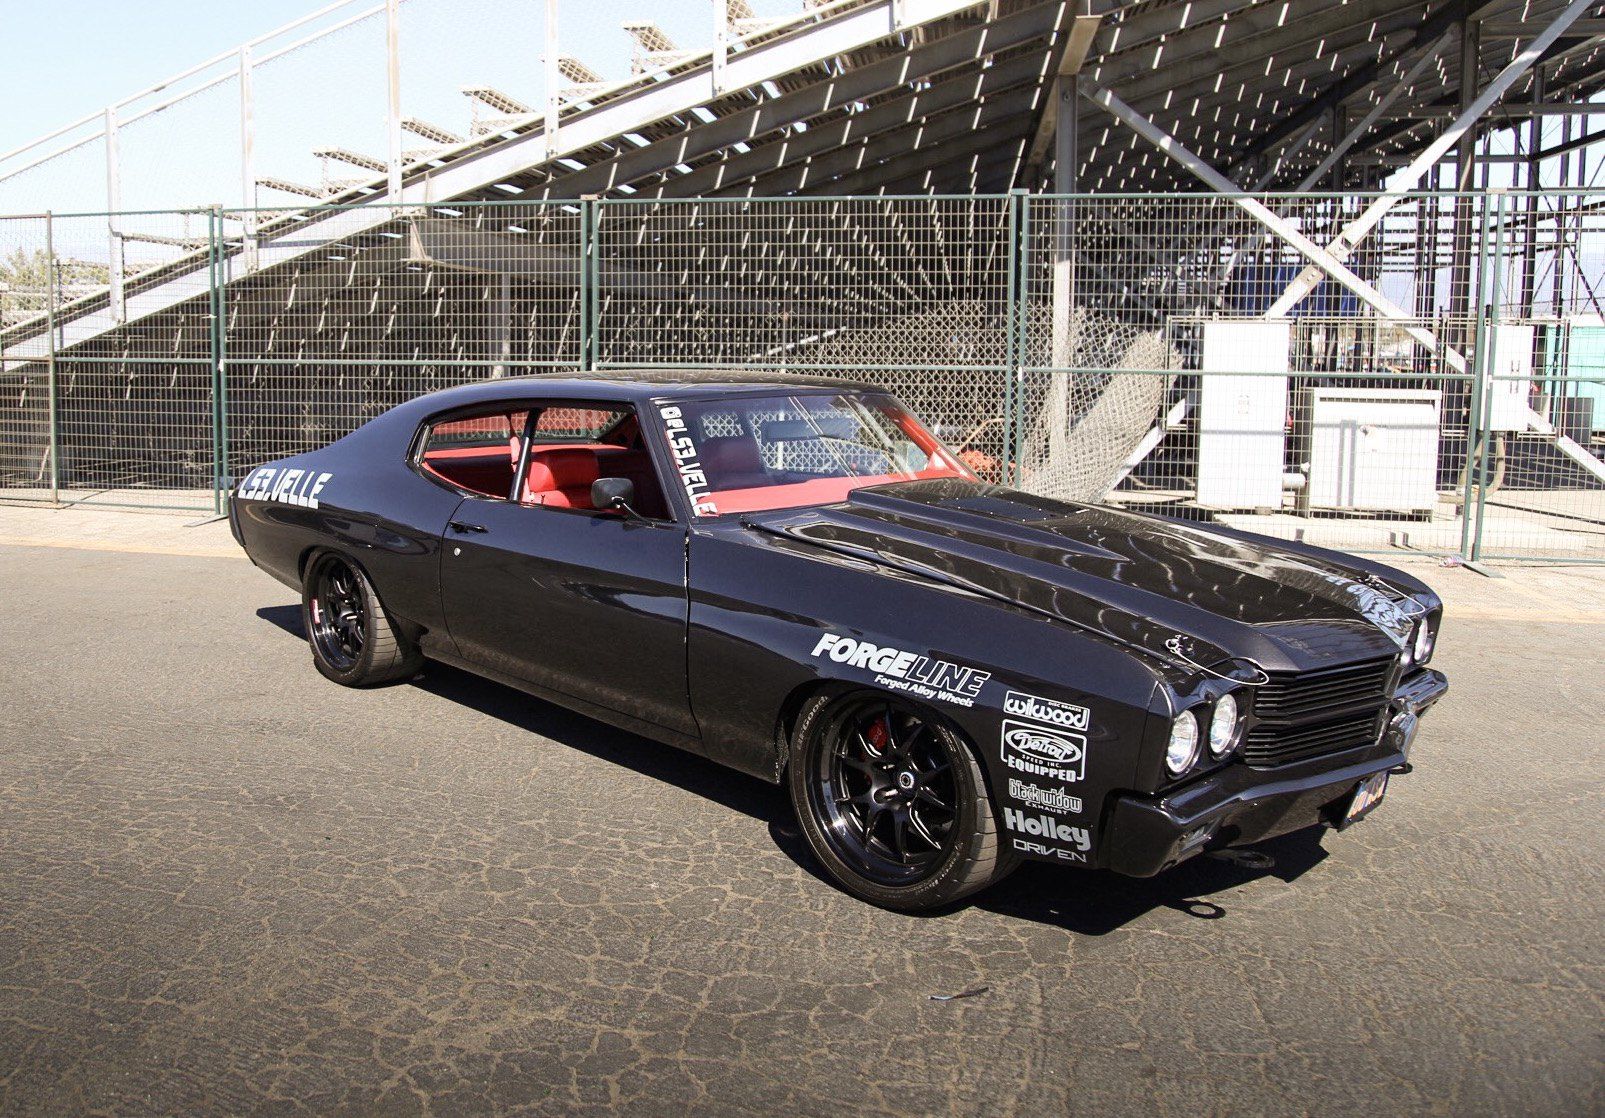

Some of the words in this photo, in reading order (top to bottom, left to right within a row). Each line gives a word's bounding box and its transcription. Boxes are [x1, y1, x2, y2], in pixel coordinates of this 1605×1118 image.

[811, 633, 992, 697] FORGELINE
[874, 674, 911, 692] Forged
[908, 682, 937, 699] Alloy
[937, 691, 975, 708] Wheels
[1006, 697, 1088, 728] wilwood
[1007, 754, 1077, 783] EQUIPPED
[1022, 754, 1044, 765] SPEED
[1008, 777, 1041, 804] black
[1040, 786, 1083, 814] widow
[1025, 800, 1068, 815] EXHAUST
[1003, 806, 1092, 852] Holley
[1013, 838, 1087, 863] DRIVEN
